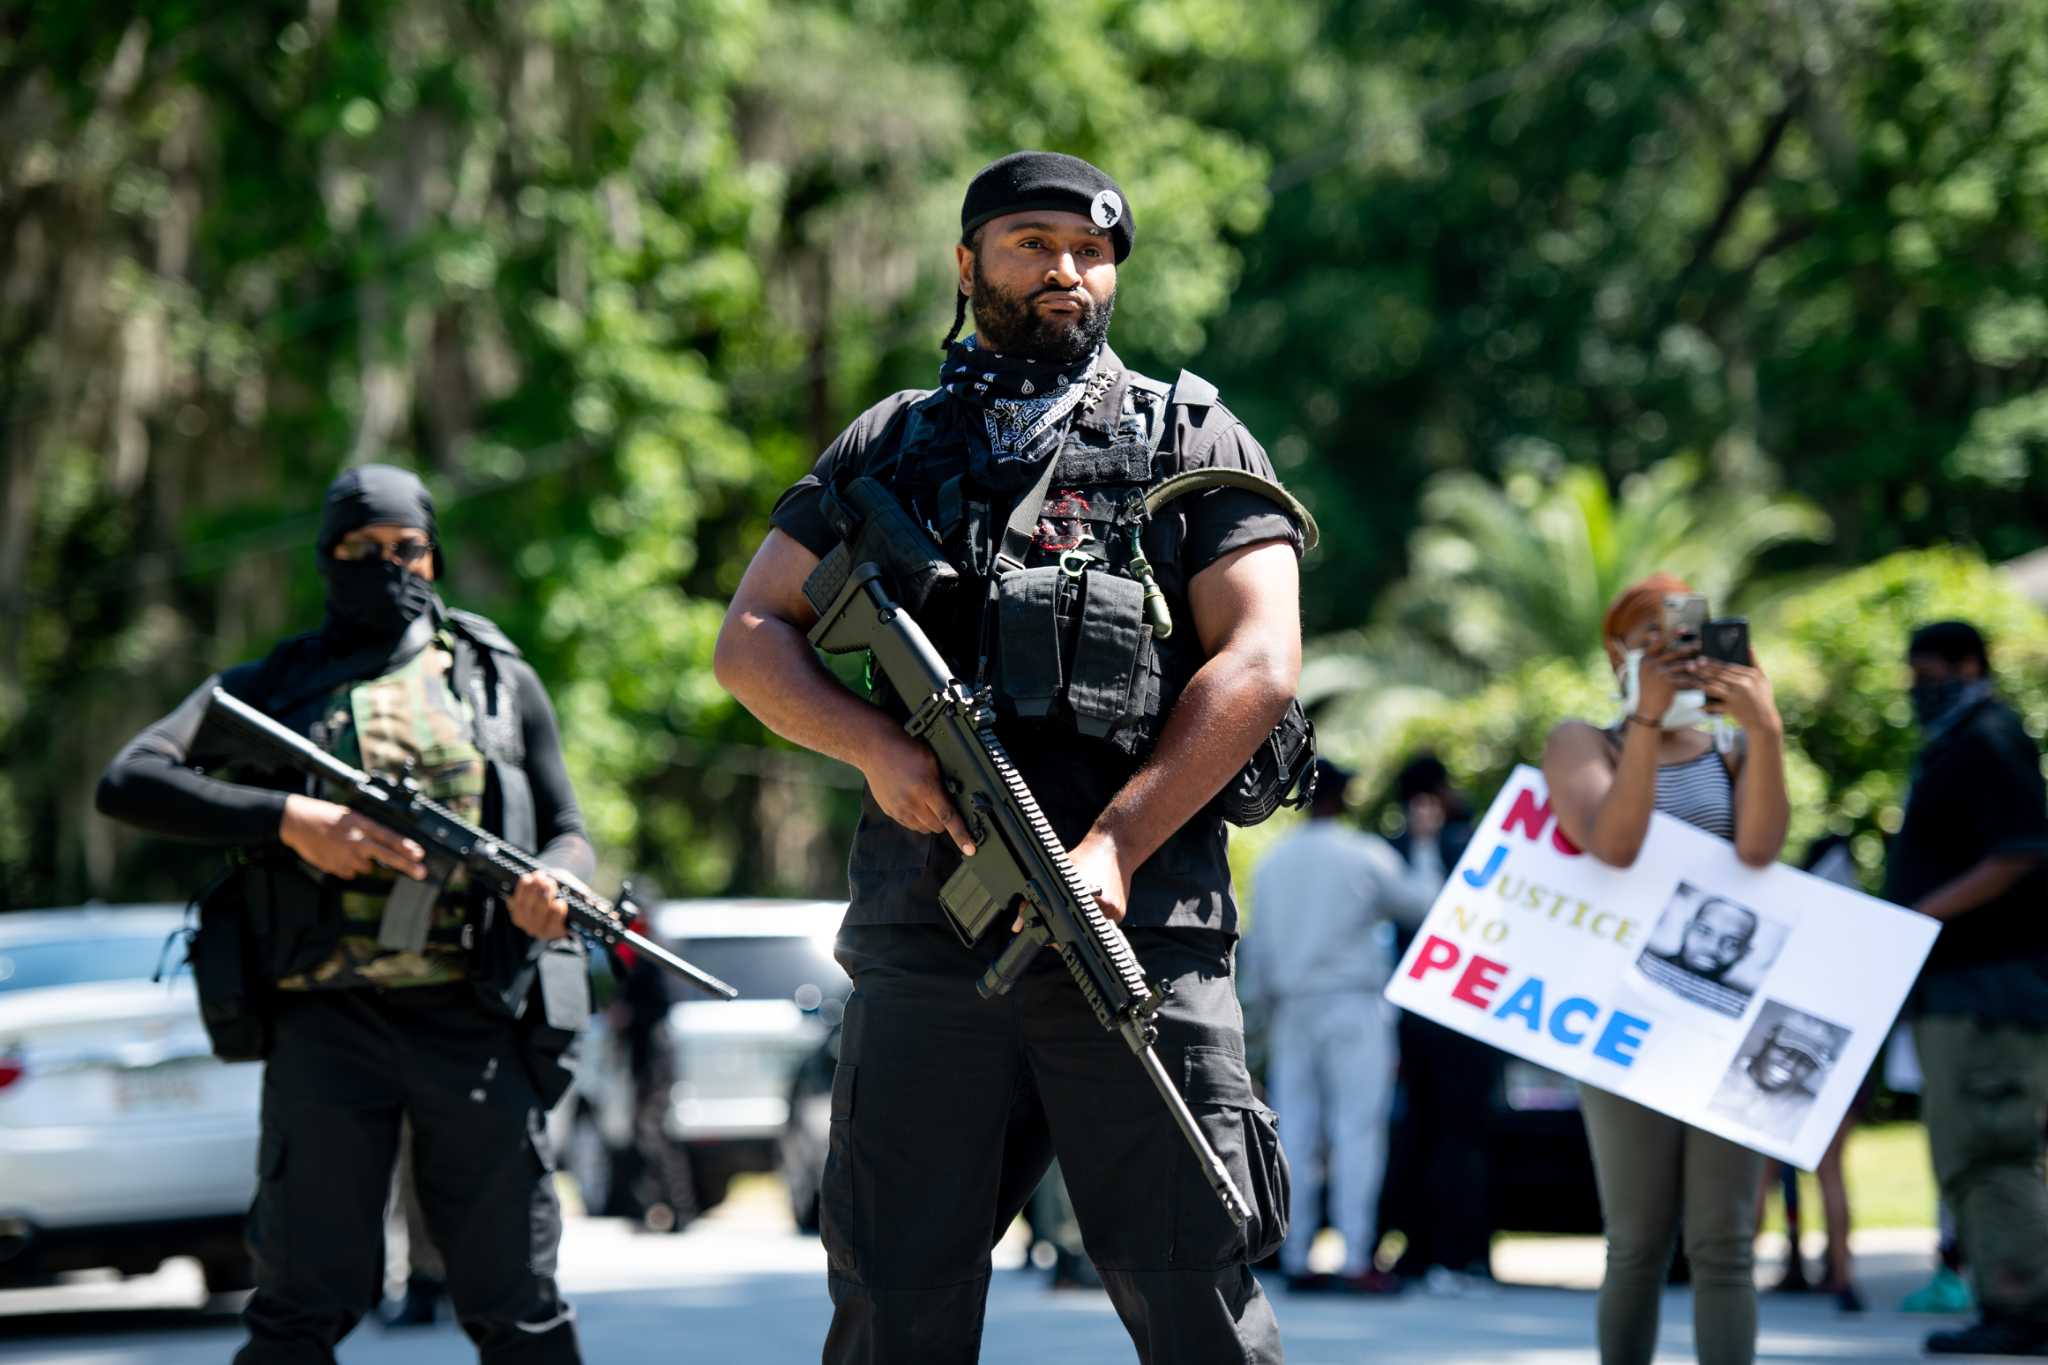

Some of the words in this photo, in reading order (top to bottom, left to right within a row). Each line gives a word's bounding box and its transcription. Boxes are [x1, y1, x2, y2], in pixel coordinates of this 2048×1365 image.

[1449, 904, 1509, 944] NO
[1462, 845, 1638, 945] JUSTICE
[1408, 934, 1652, 1067] PEACE
